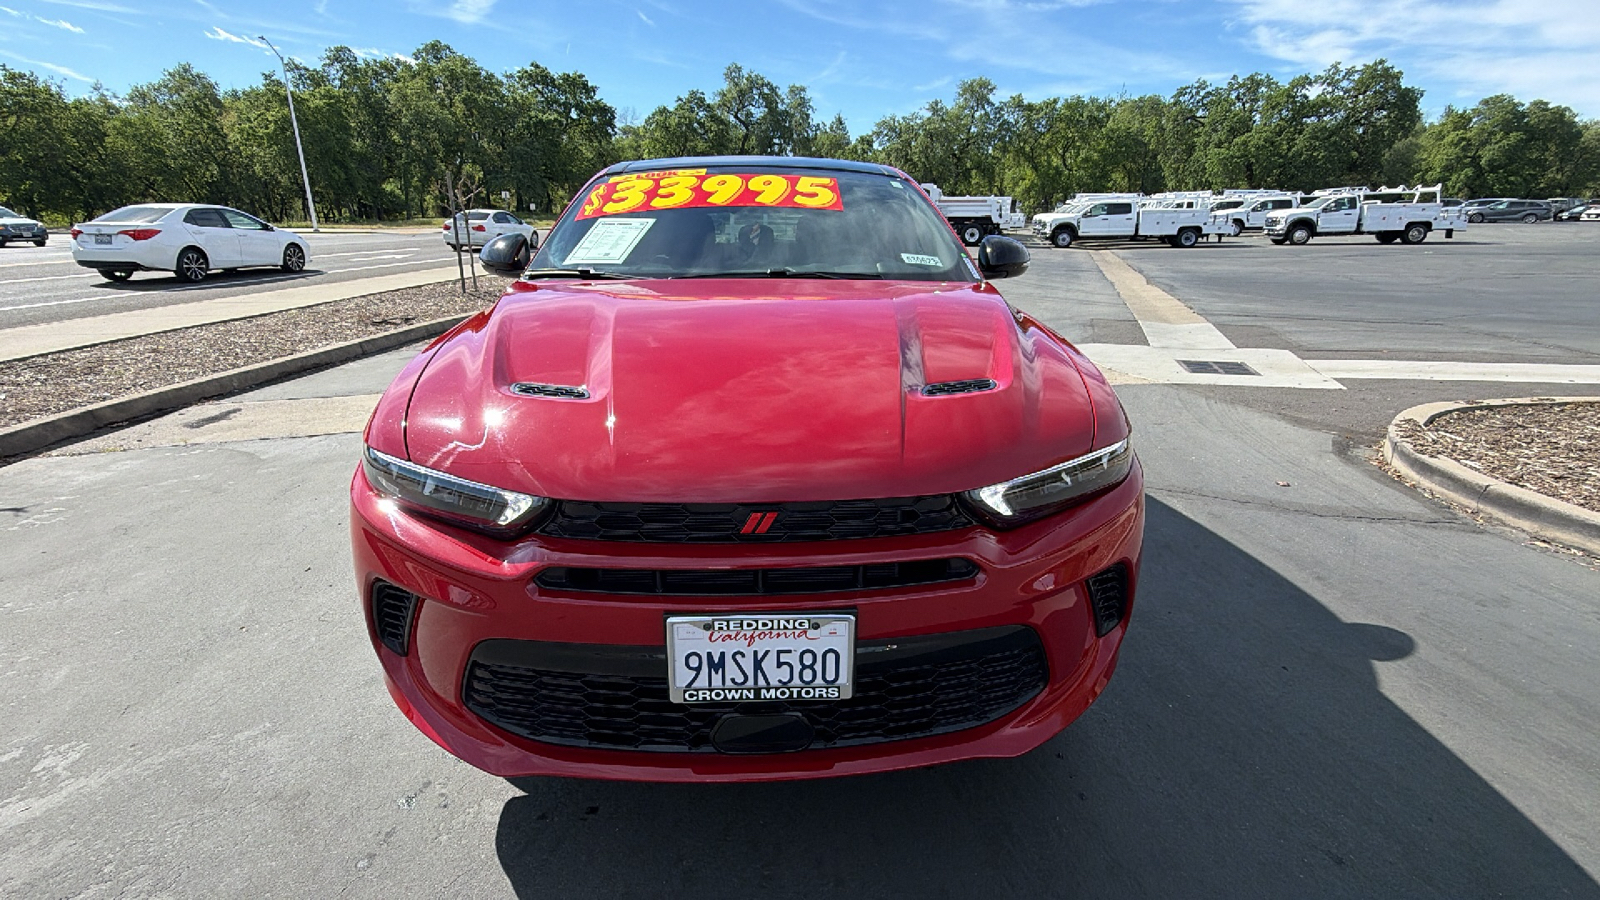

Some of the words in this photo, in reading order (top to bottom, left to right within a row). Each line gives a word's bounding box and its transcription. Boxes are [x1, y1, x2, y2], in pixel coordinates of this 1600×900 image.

[584, 174, 837, 216] $33995
[713, 619, 810, 631] REDDING
[708, 629, 821, 647] California
[684, 647, 841, 688] 9MSK580
[684, 688, 755, 701] CROWN
[760, 687, 840, 699] MOTORS
